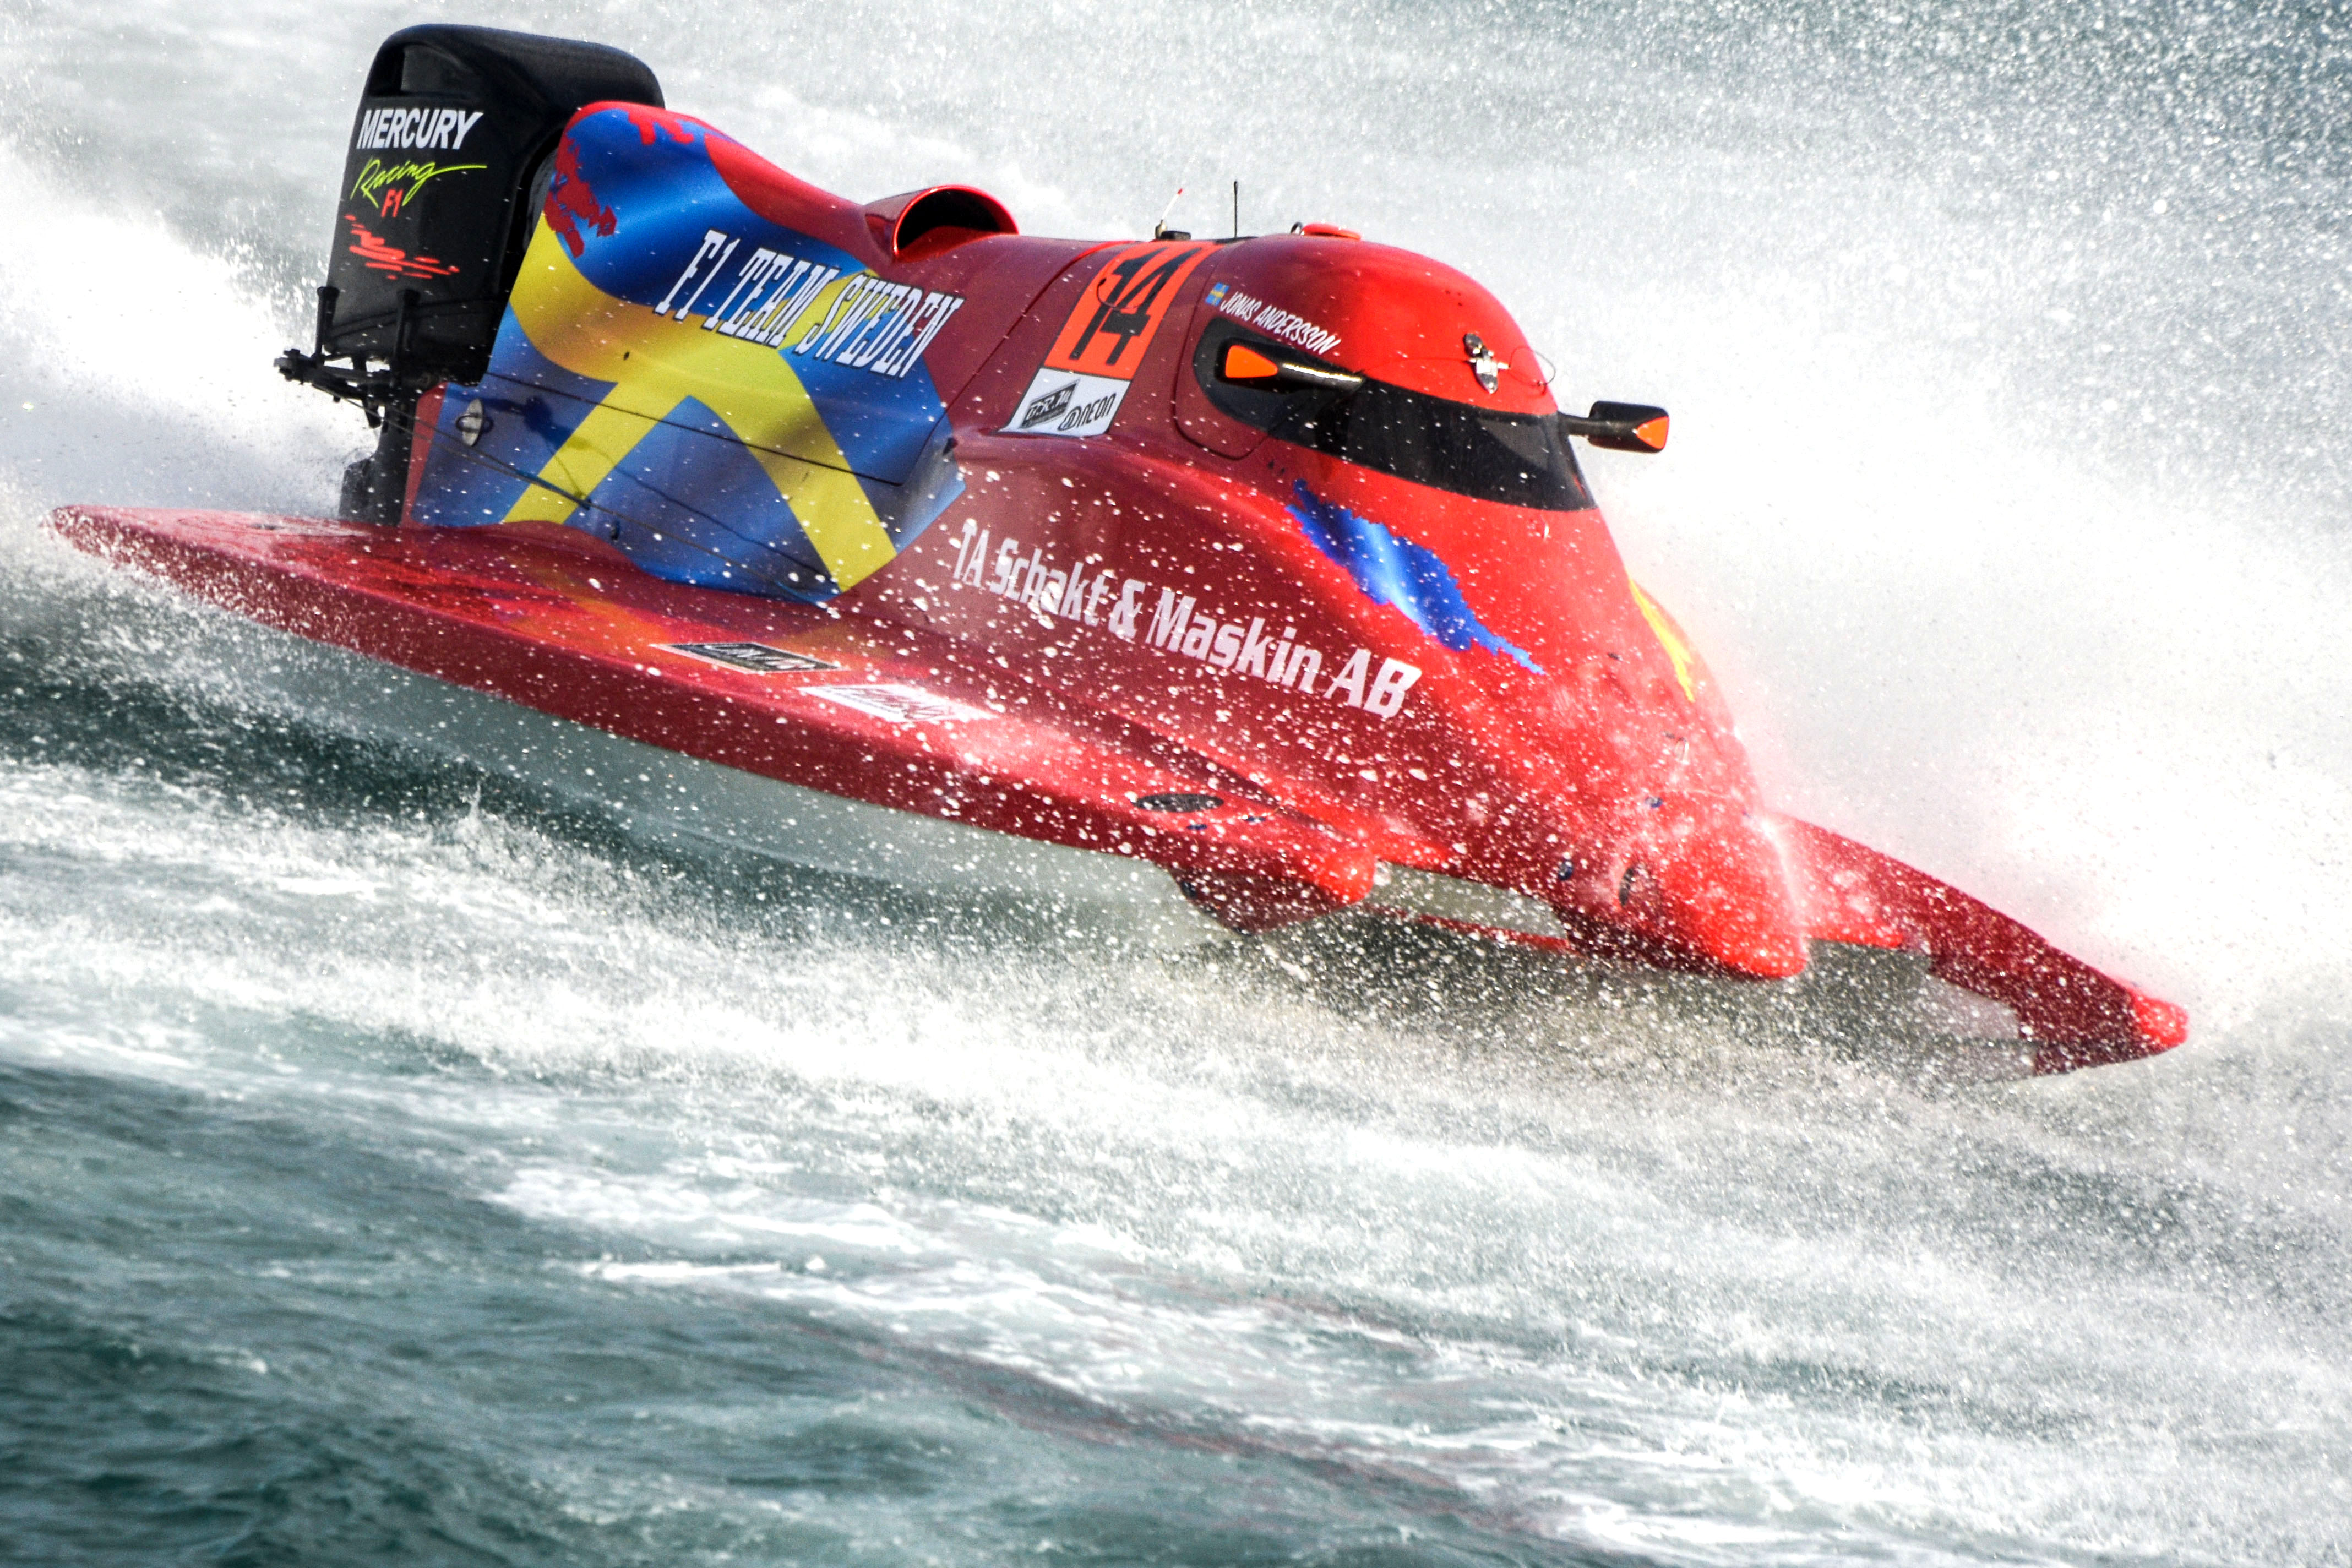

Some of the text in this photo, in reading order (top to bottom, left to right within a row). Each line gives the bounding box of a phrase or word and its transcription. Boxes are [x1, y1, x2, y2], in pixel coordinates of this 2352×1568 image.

[356, 108, 484, 150] MERCURY
[350, 156, 488, 208] Racing
[380, 188, 404, 217] F1
[654, 228, 965, 379] F1 TEAM SWEDEN
[1069, 246, 1202, 366] 14
[1219, 291, 1342, 355] JONAS ANDERSSON
[953, 519, 1422, 718] TA Schakt & Maskin AB
